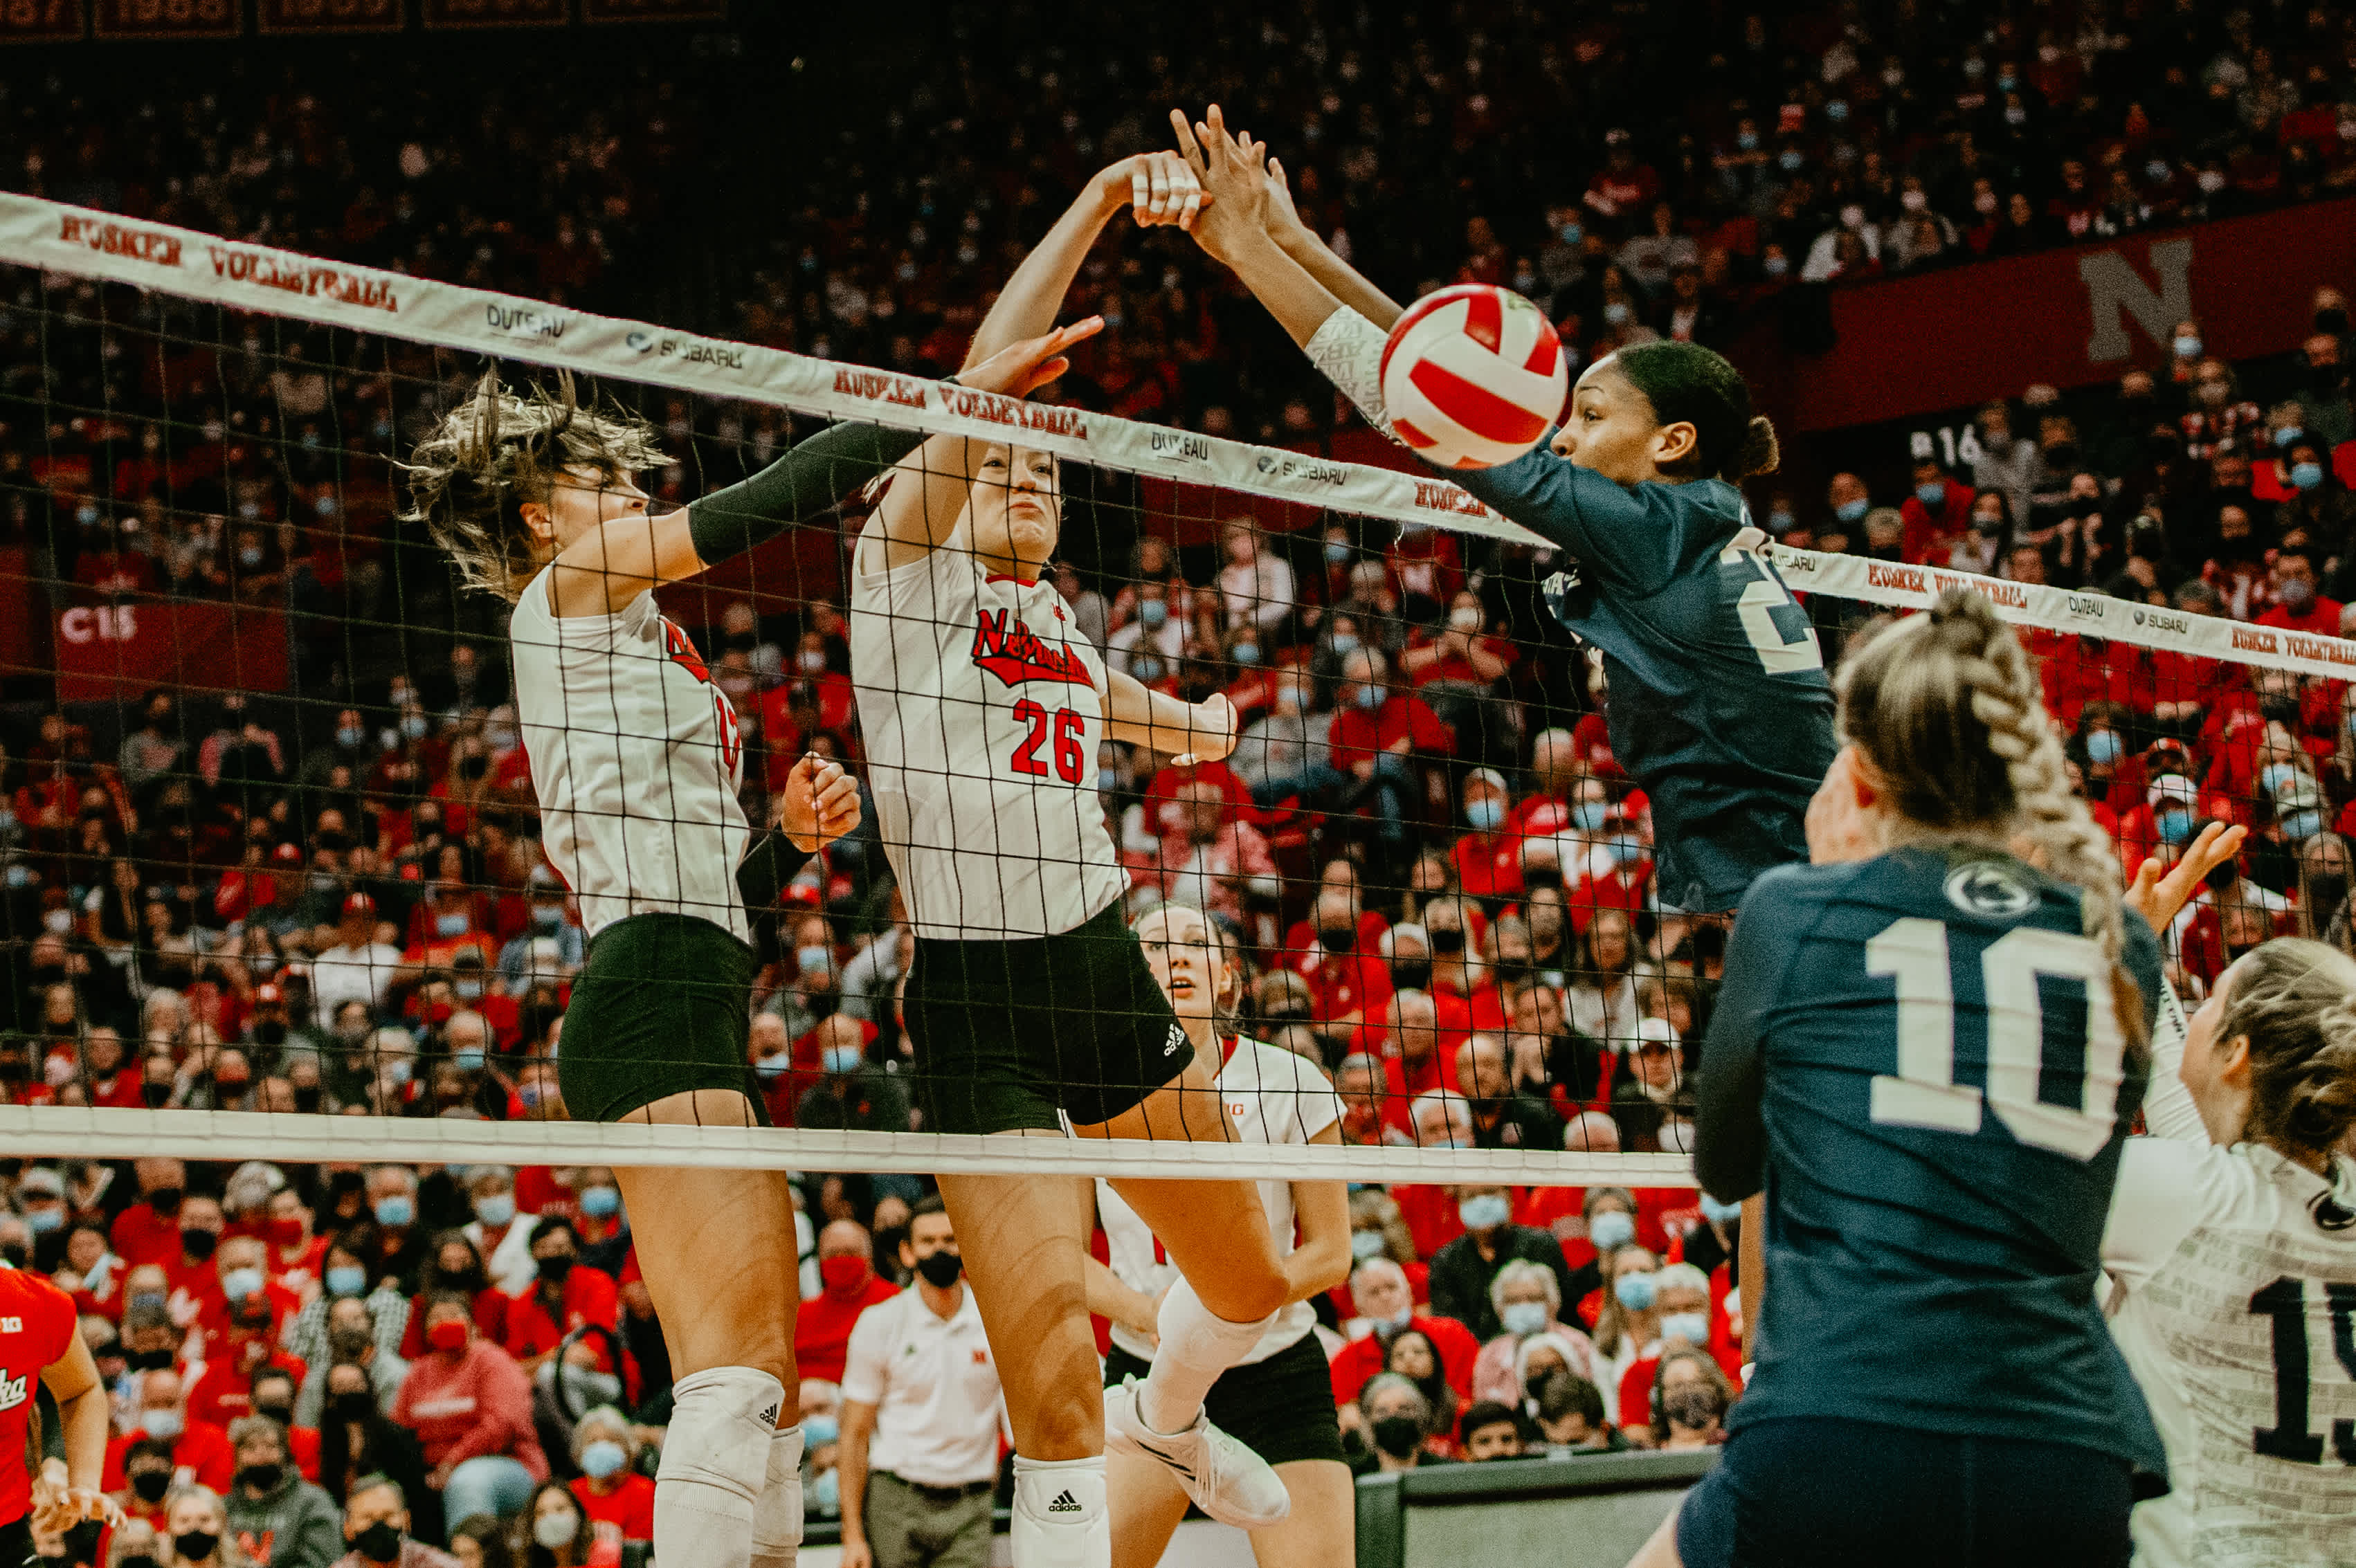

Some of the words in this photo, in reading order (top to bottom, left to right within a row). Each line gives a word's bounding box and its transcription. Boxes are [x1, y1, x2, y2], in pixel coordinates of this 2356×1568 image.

[60, 214, 183, 267] HUSKER
[207, 244, 399, 313] VOLLEYBALL
[2080, 237, 2195, 361] N
[487, 304, 565, 338] DUTEAU
[659, 338, 744, 370] SUBARU
[833, 368, 927, 410] HUSKER
[937, 384, 1088, 441] VOLLEYBALL
[1283, 462, 1348, 486] SUBARU
[2068, 596, 2104, 617] DUTEAU
[2148, 615, 2188, 635] SUBARU
[1011, 697, 1085, 785] 26
[1865, 916, 2126, 1162] 10
[1048, 1503, 1082, 1512] adidas
